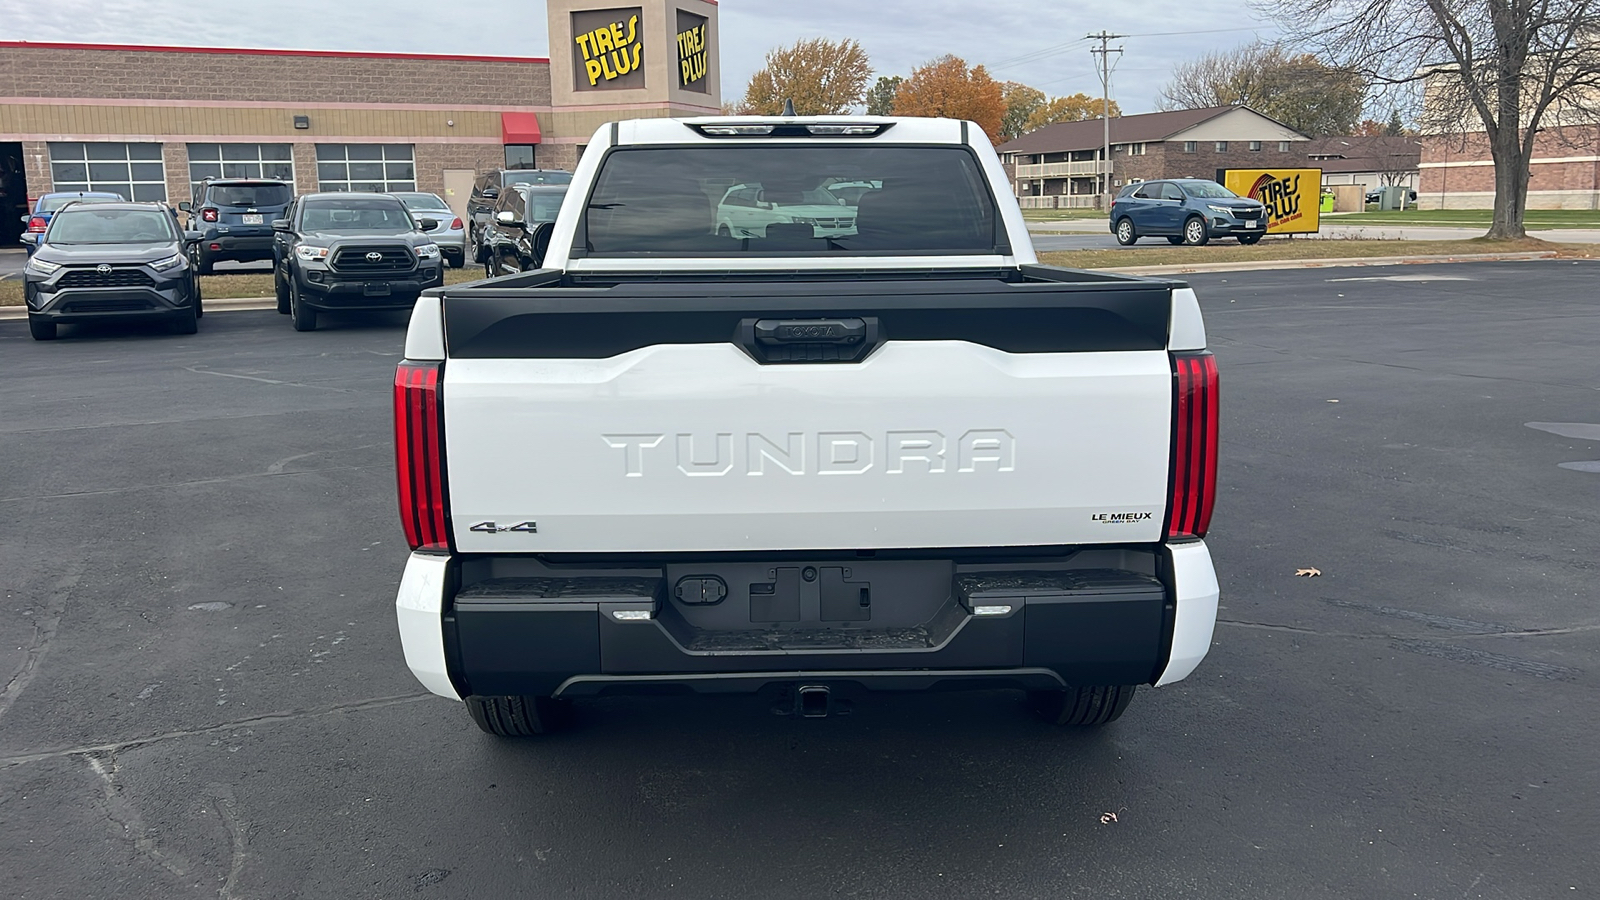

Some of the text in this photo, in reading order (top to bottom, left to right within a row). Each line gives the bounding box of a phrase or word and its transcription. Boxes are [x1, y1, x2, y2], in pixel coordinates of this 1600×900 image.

[575, 14, 638, 60] TIRES
[676, 23, 705, 59] TIRES
[585, 41, 642, 86] PLUS
[681, 49, 707, 86] PLUS
[1259, 173, 1300, 204] TIRES
[1265, 193, 1301, 223] PLUS
[785, 326, 836, 338] TOYOTA
[600, 428, 1015, 477] TUNDRA
[1110, 512, 1152, 520] MIEUX
